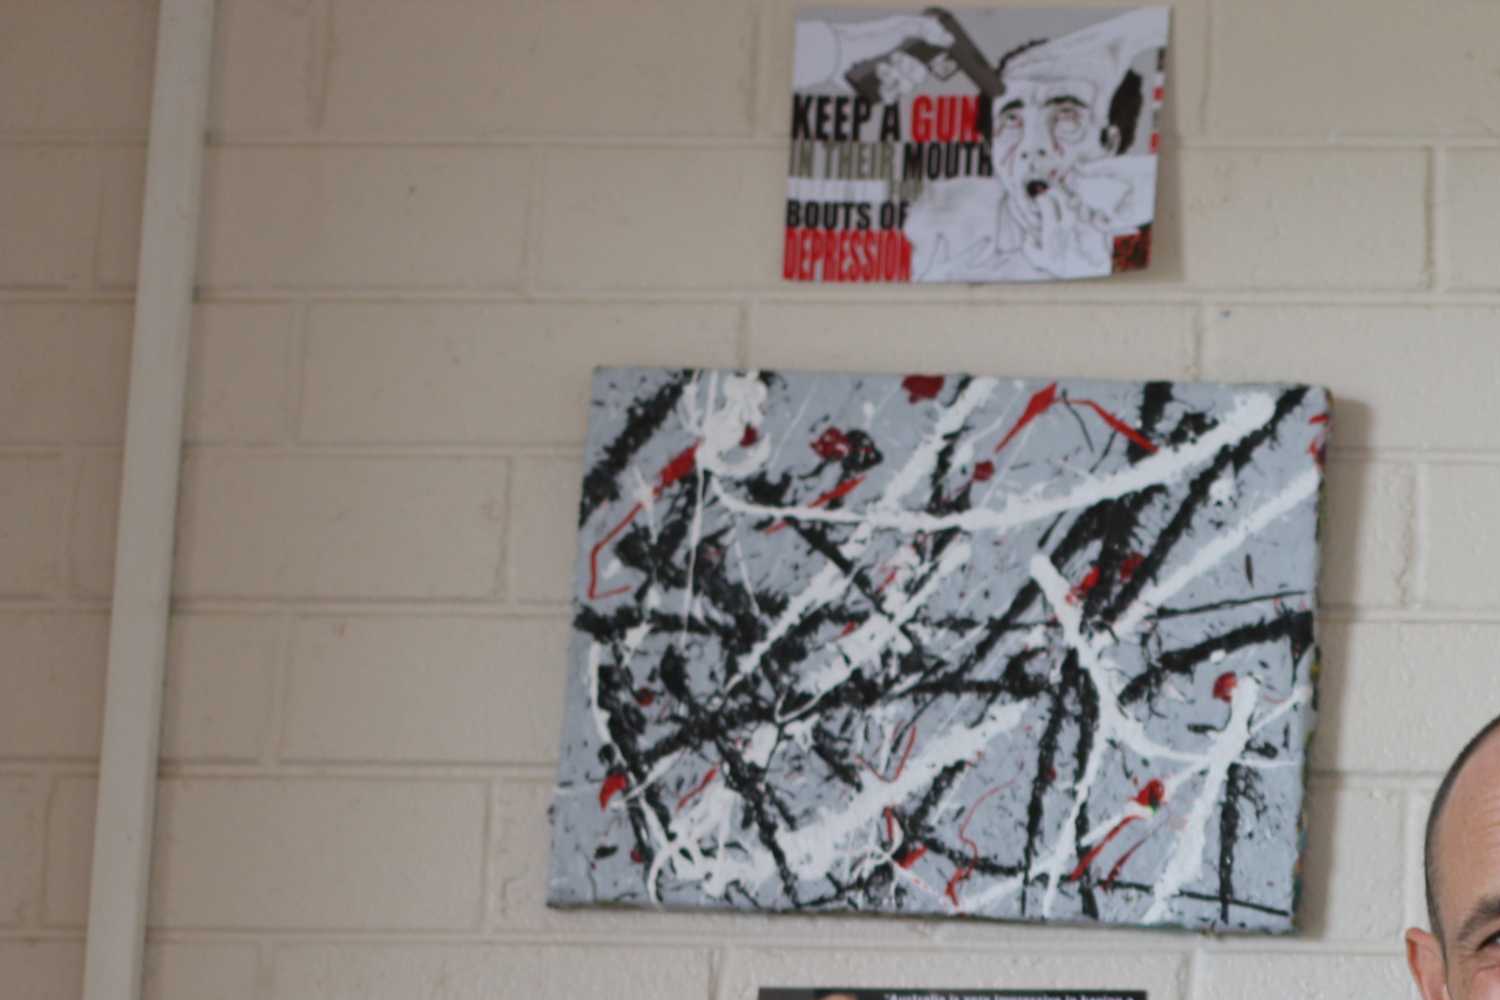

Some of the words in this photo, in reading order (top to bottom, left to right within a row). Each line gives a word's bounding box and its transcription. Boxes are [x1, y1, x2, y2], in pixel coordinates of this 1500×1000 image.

[791, 94, 871, 142] KEEP
[881, 102, 900, 143] A
[911, 95, 990, 144] GUN
[902, 143, 994, 181] MOUTH
[787, 200, 871, 230] BOUTS
[880, 200, 909, 231] OF
[783, 229, 913, 282] DEPRESSION
